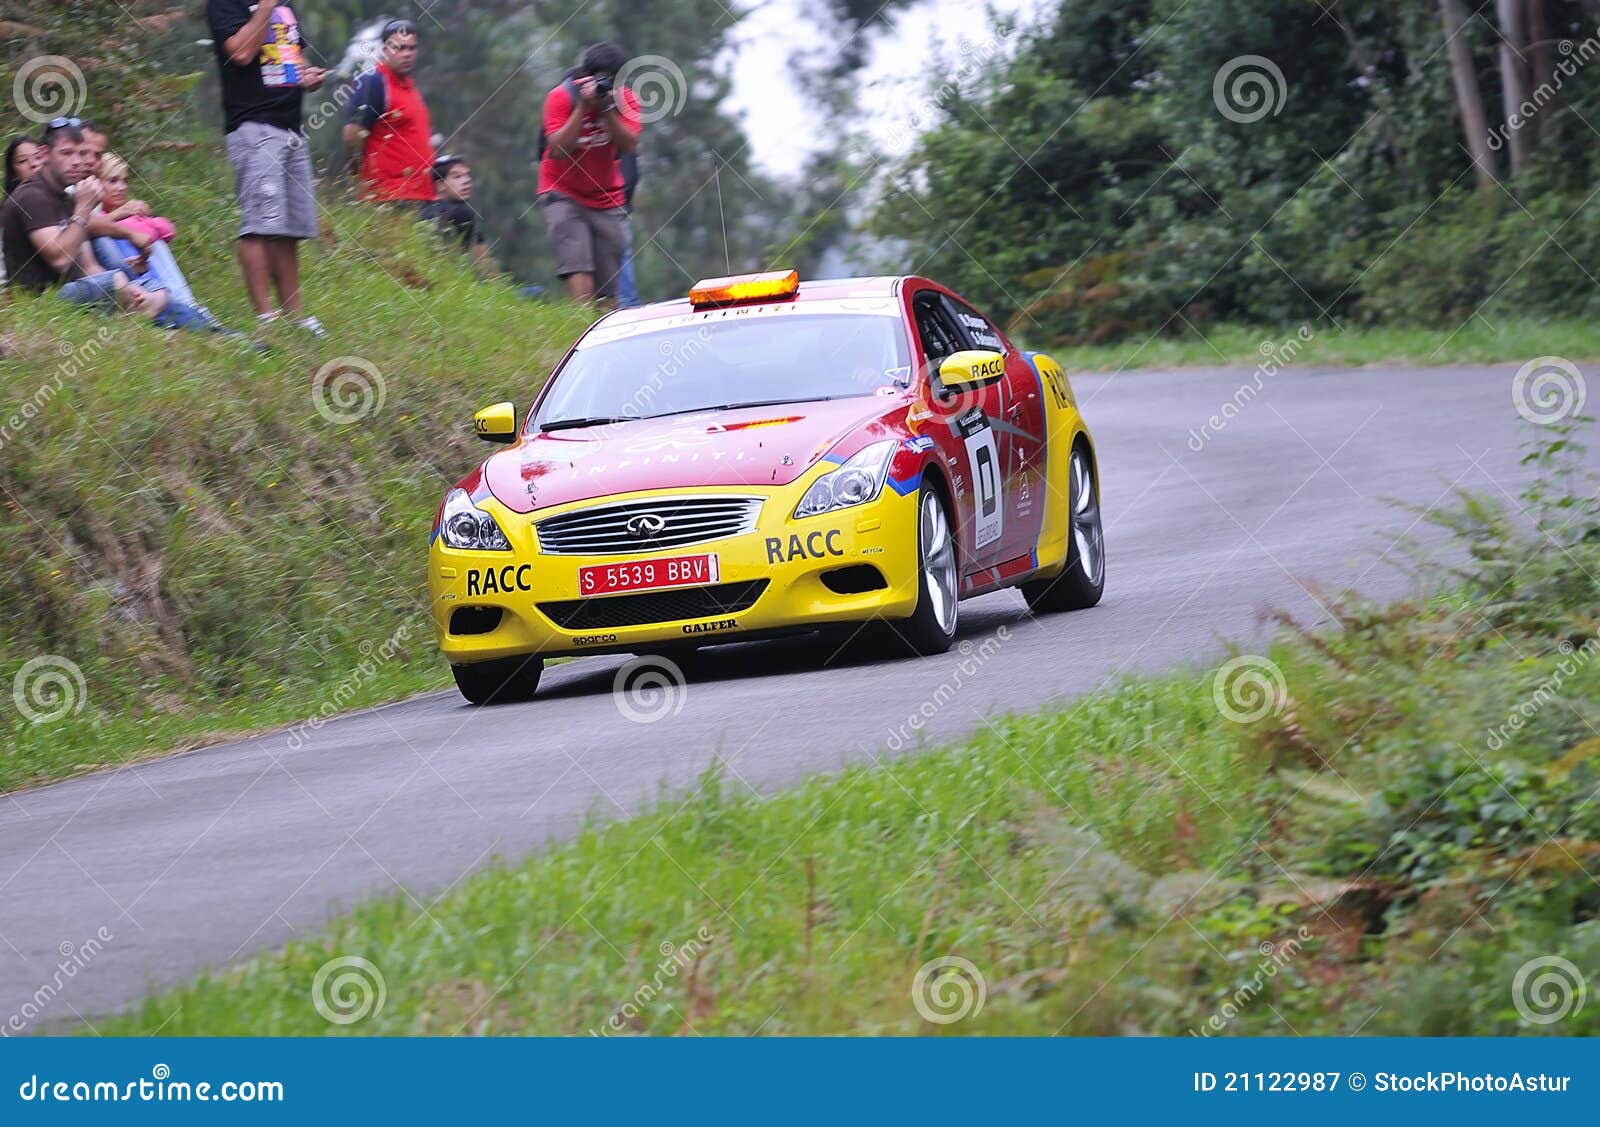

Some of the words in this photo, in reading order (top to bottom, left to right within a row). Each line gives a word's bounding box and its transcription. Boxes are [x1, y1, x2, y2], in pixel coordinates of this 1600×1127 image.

[972, 360, 1002, 378] RACC
[766, 529, 843, 564] RACC
[467, 564, 532, 597] RACC
[584, 571, 595, 590] S
[607, 564, 655, 587] 5539
[668, 559, 703, 581] BBV
[682, 618, 738, 634] GALFER
[572, 634, 617, 646] sparco
